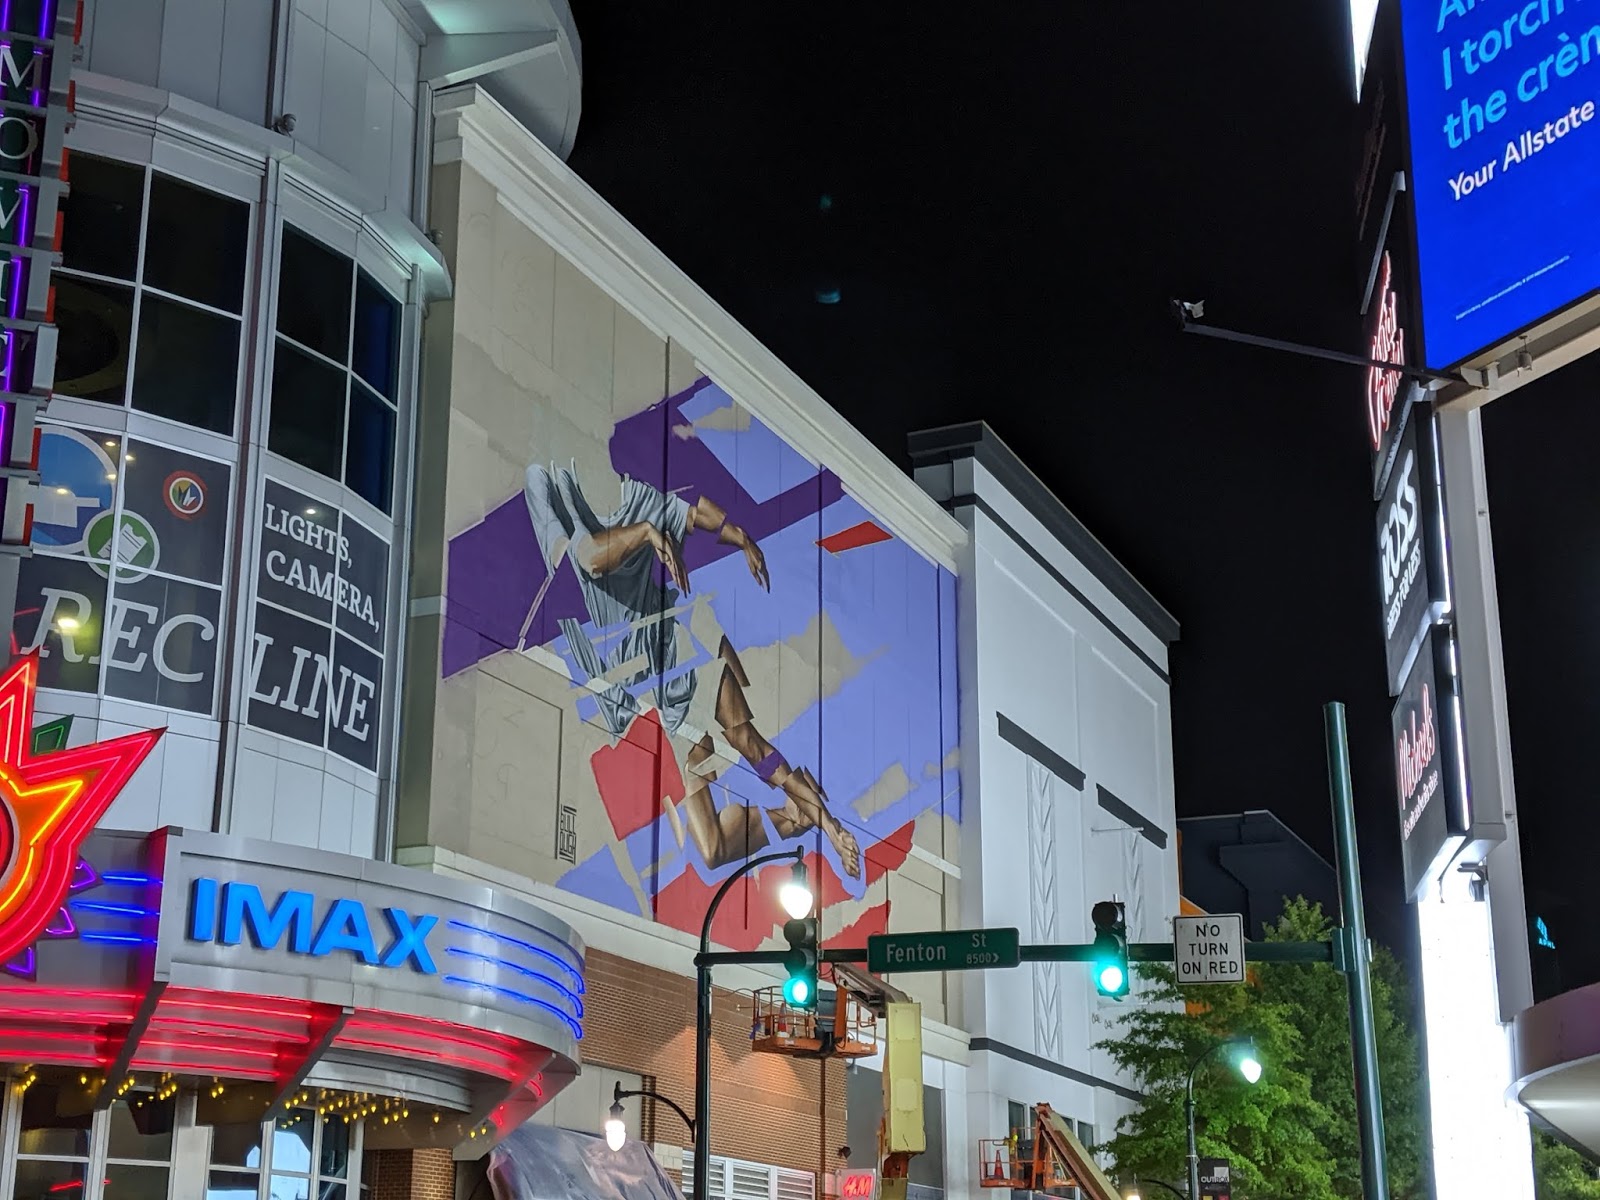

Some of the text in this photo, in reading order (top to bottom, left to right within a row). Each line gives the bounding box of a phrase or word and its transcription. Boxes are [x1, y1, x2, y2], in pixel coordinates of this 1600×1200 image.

[1442, 46, 1453, 90] I
[1443, 89, 1507, 149] the
[1448, 100, 1595, 201] Your Allstate
[265, 503, 353, 569] LIGHTS,
[1380, 449, 1418, 604] ROSS
[266, 550, 380, 633] CAMERA,
[191, 877, 440, 975] IMAX
[886, 933, 987, 964] Fenton St
[1188, 942, 1229, 957] TURN
[1195, 924, 1220, 938] NO
[966, 952, 992, 965] 8500
[1181, 960, 1239, 975] ON RED
